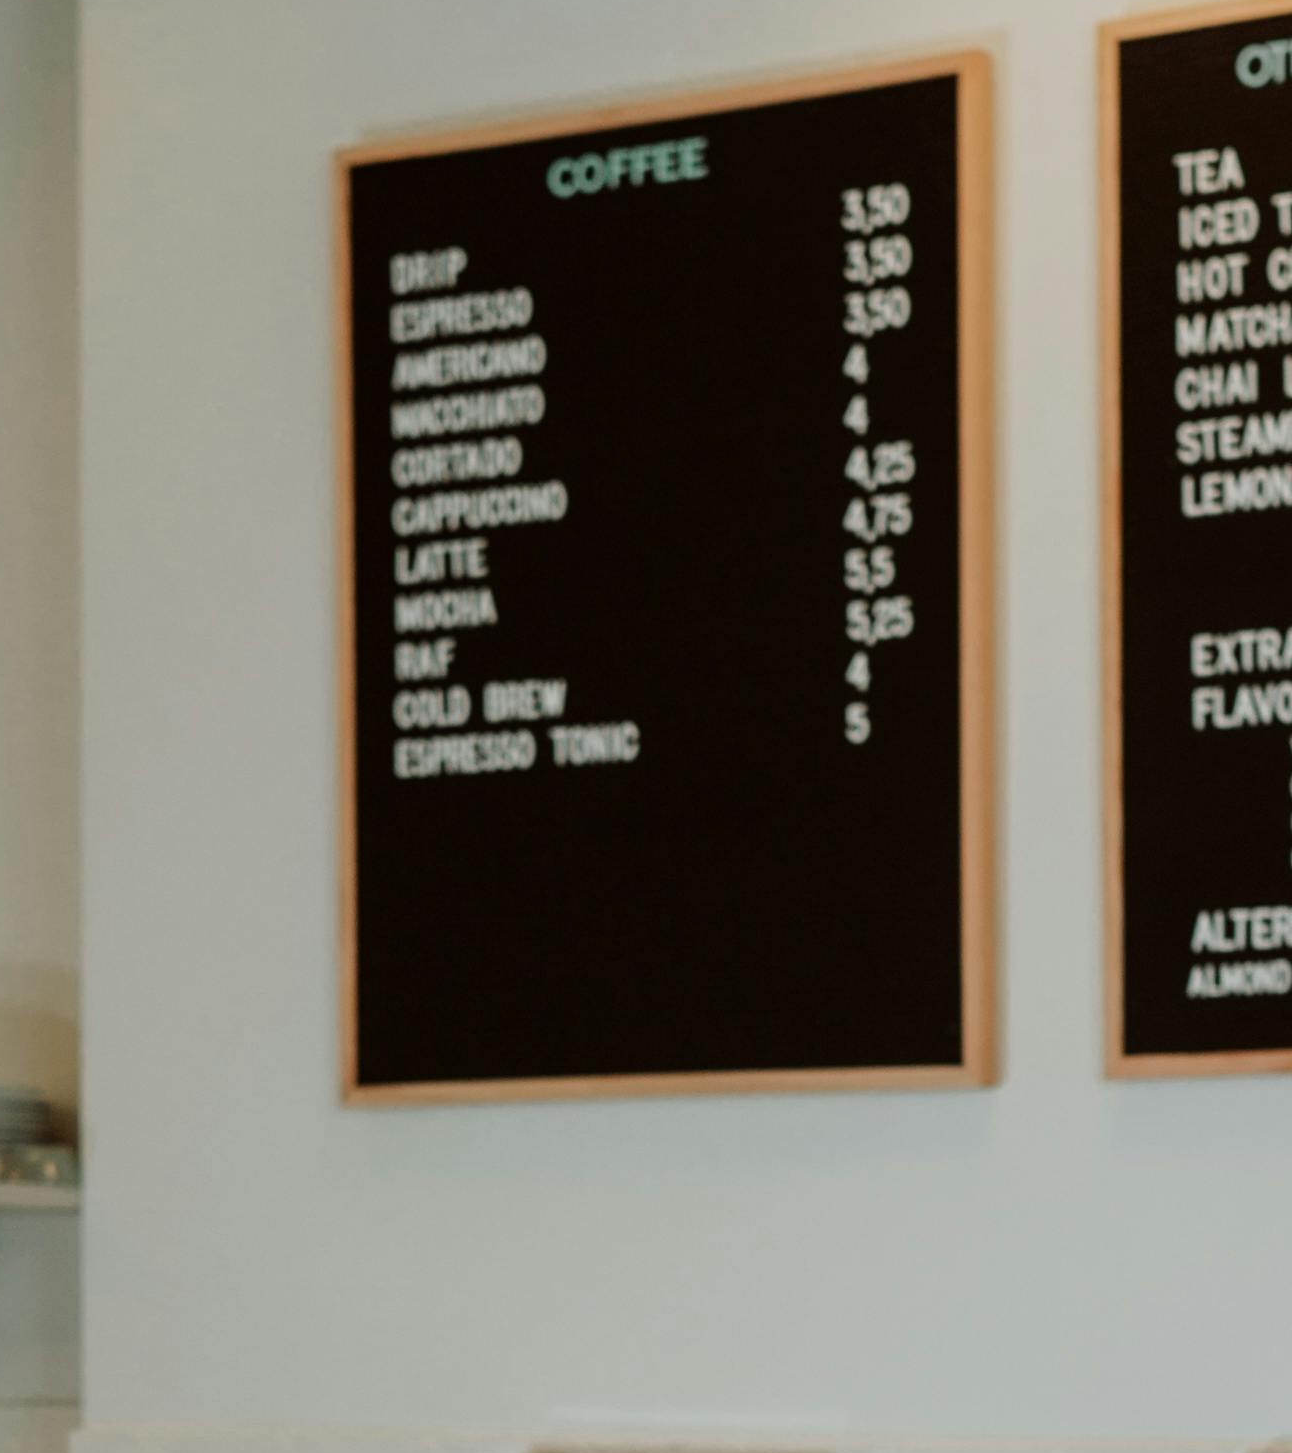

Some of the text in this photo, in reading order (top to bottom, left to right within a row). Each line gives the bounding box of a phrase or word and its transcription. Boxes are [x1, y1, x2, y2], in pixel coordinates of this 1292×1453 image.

[548, 138, 706, 197] COFFEE
[1174, 147, 1244, 195] TEA
[1179, 197, 1260, 249] ICED
[391, 248, 467, 294] DRIP
[1176, 253, 1249, 303] HOT
[391, 289, 532, 342] ESPRESSO
[393, 336, 545, 389] AMERICANO
[844, 345, 868, 383] 4
[1175, 361, 1258, 410] CHAI
[392, 396, 868, 487] CORTADO 4
[395, 538, 486, 584] LATTE
[395, 589, 496, 631] MOCHA
[395, 639, 454, 679] RAF
[394, 653, 870, 729] COLD BREW 4
[394, 703, 870, 778] ESPRESSO TONIC 5
